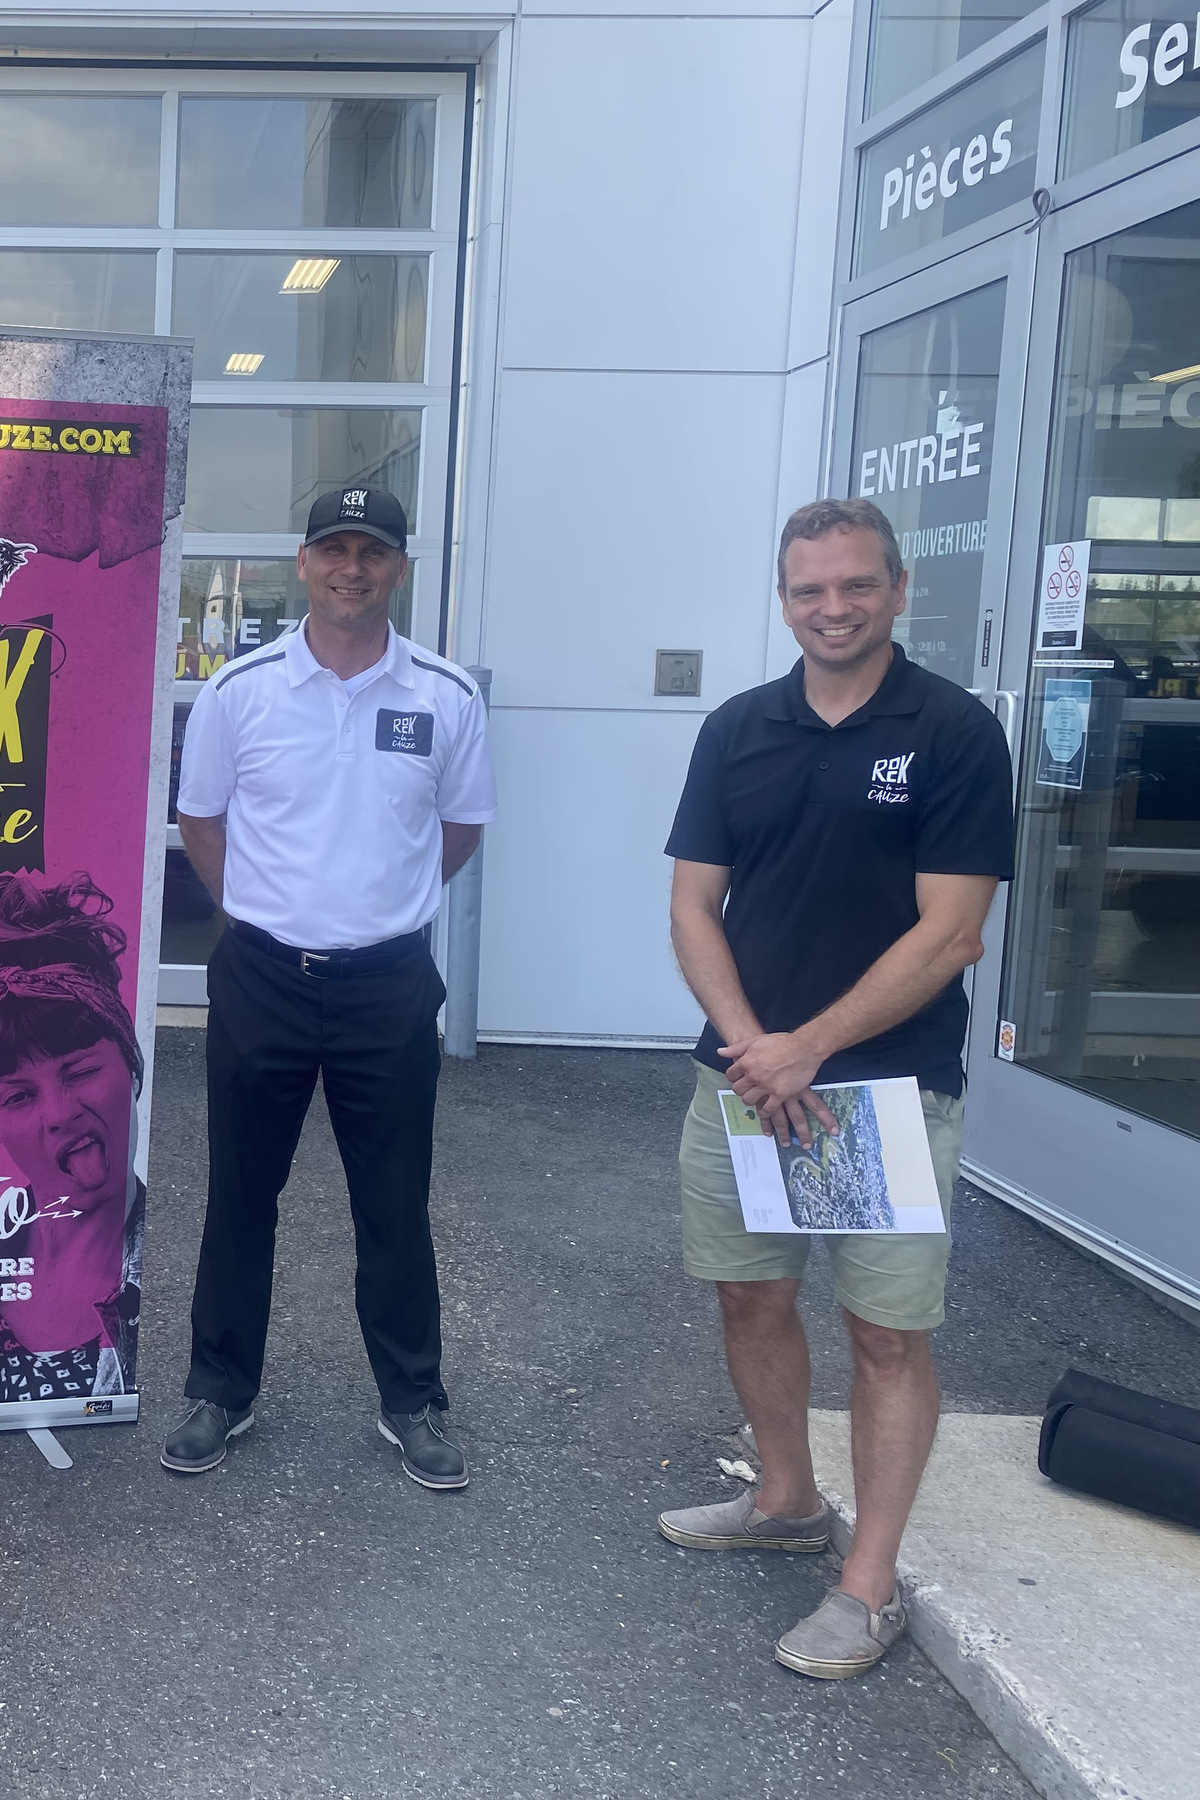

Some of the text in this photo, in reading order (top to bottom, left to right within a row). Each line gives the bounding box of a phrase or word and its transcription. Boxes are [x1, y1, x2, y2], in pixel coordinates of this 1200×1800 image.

[1114, 12, 1200, 109] Se
[880, 119, 1013, 231] Pièces
[901, 519, 988, 560] D'OUVERTURE
